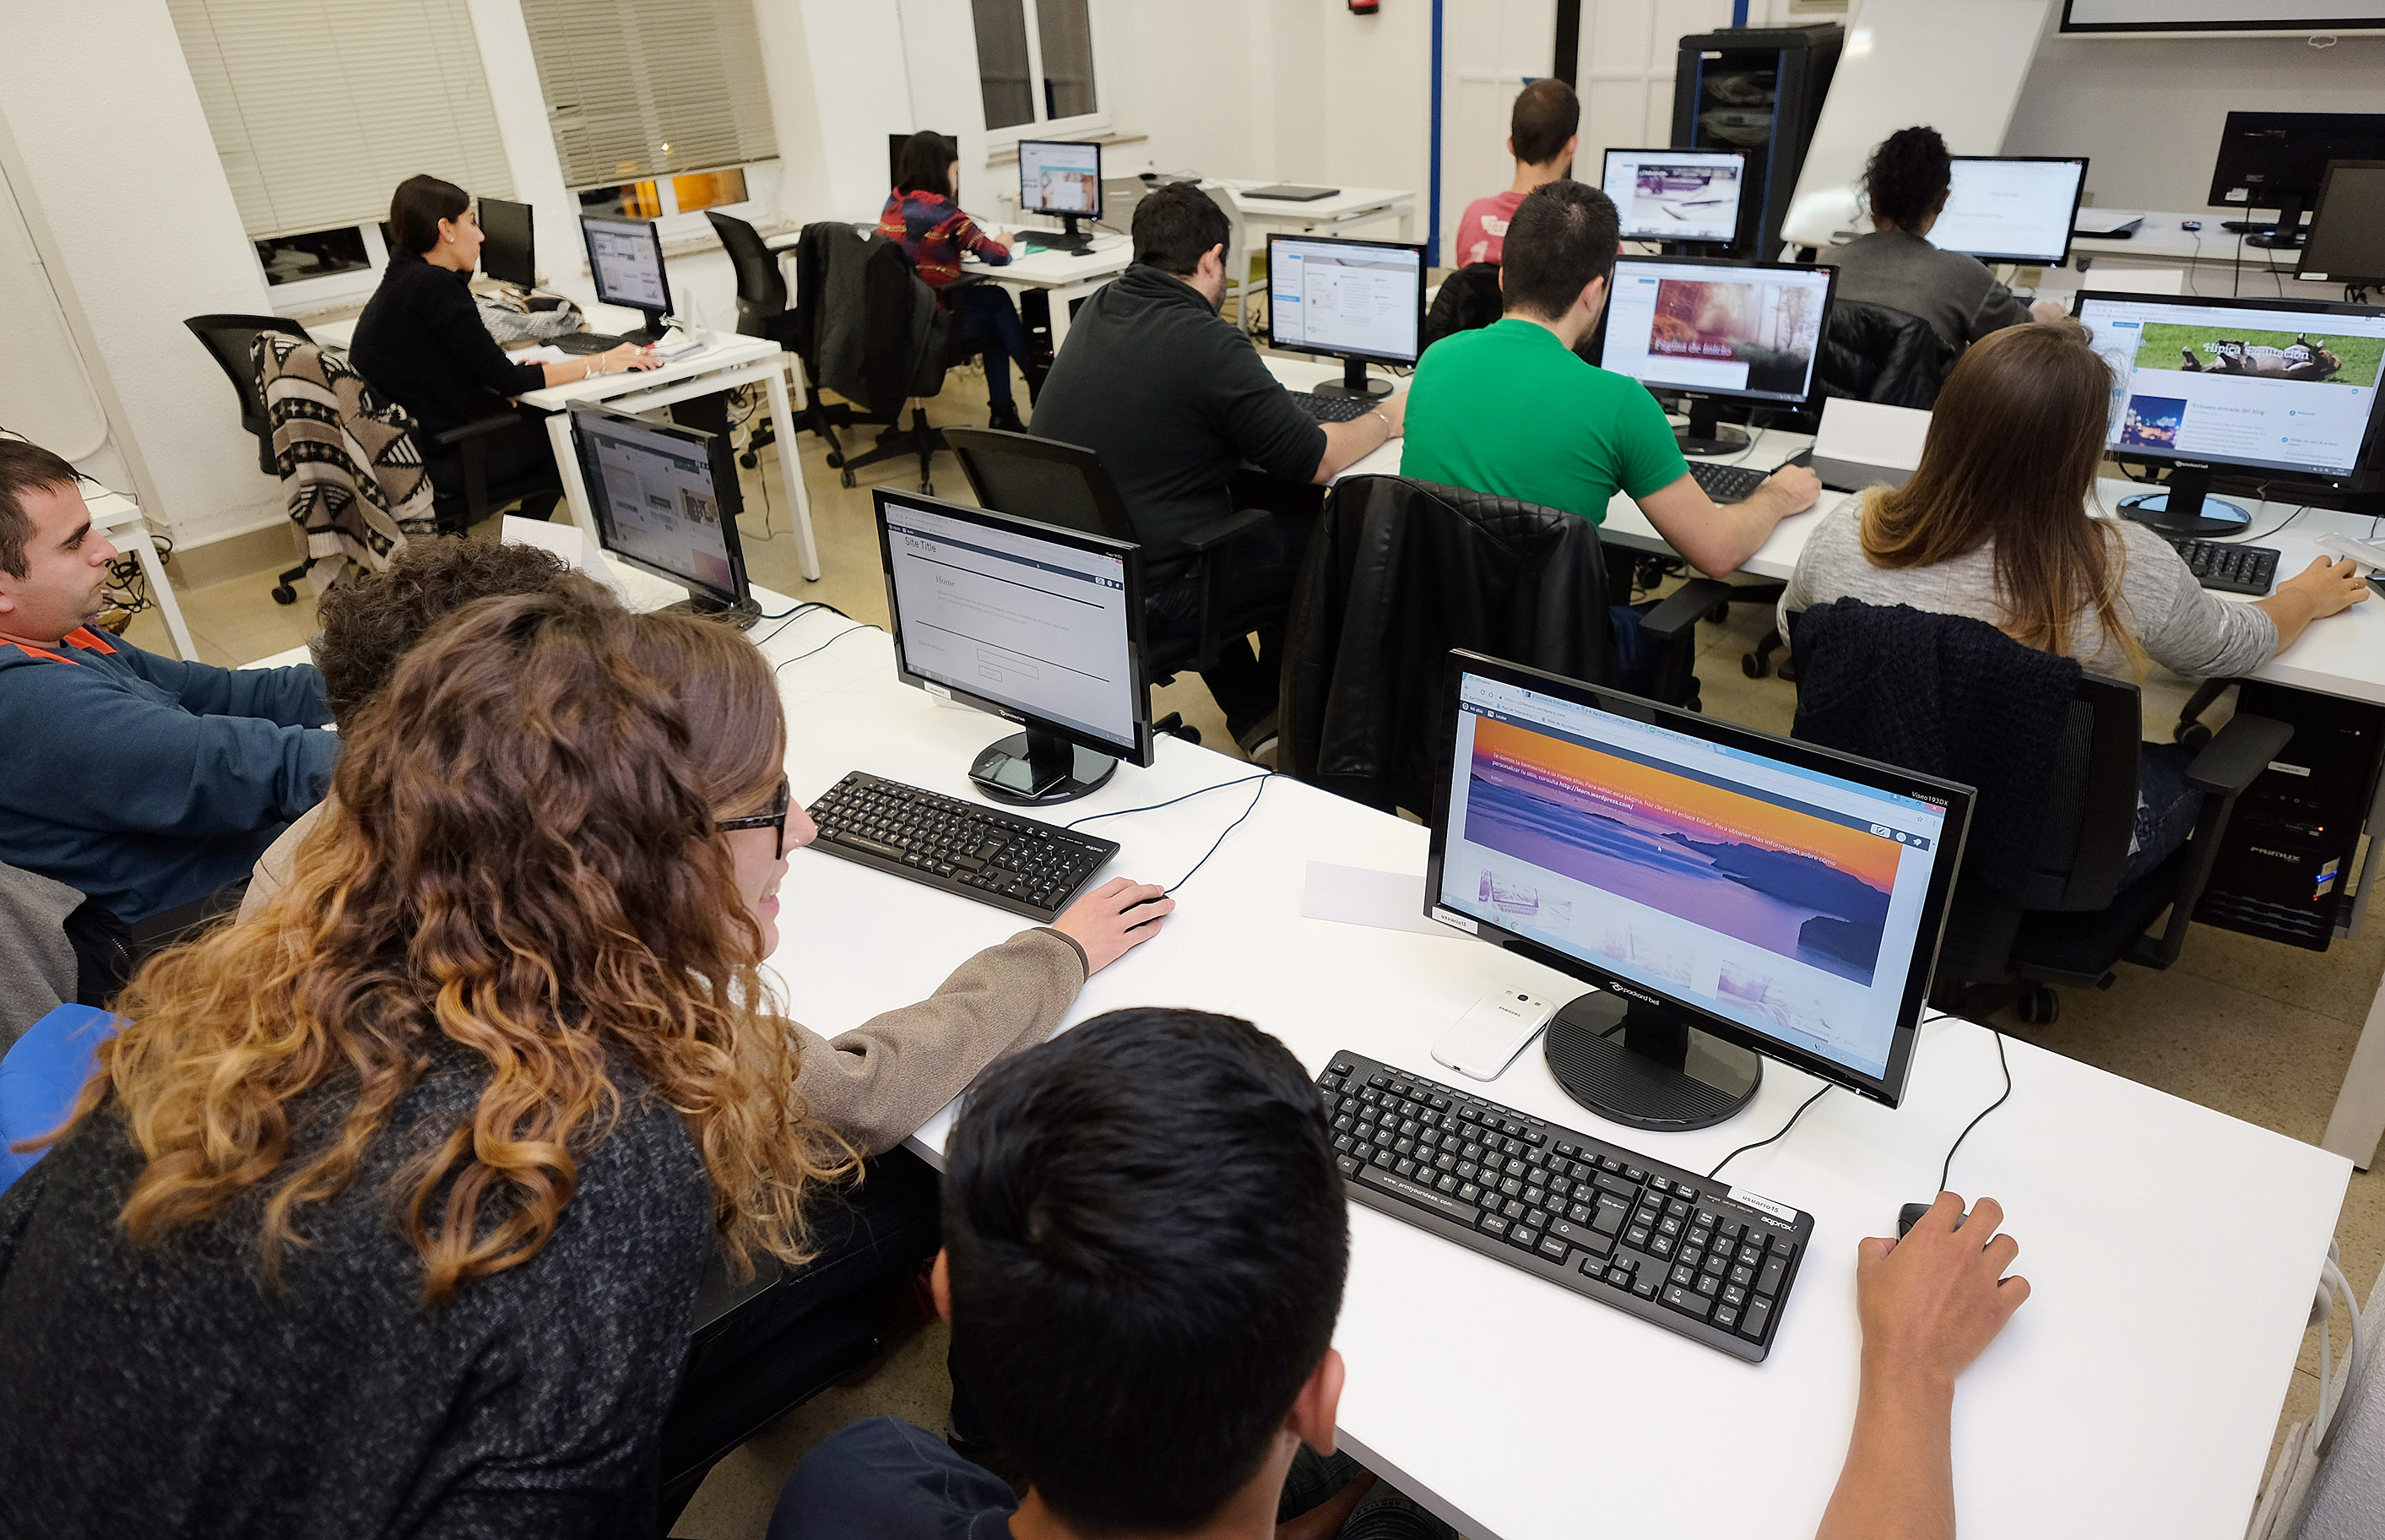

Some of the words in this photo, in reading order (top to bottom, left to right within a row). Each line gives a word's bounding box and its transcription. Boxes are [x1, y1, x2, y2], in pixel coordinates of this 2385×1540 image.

[904, 536, 919, 549] Site
[921, 540, 937, 553] Title
[935, 575, 956, 588] Home
[1492, 760, 1520, 774] personalizar
[1538, 774, 1559, 787] consulta
[1911, 791, 1949, 806] Viseo193DX
[1499, 754, 1515, 765] damos
[1520, 759, 1547, 775] bienvenida
[1558, 773, 1573, 783] nuevo
[1585, 781, 1597, 790] Para
[1597, 784, 1613, 795] editar
[1613, 789, 1624, 800] esta
[1654, 802, 1663, 811] clic
[1678, 810, 1696, 822] enlace
[1715, 822, 1728, 832] Para
[1728, 827, 1751, 839] obtener
[1751, 833, 1764, 843] más
[1764, 837, 1800, 855] información
[1801, 850, 1818, 861] sobre
[1819, 854, 1837, 867] cómo
[1440, 914, 1467, 927] usuario15
[1623, 987, 1648, 1002] packard
[1648, 993, 1660, 1006] bell
[1383, 1176, 1397, 1185] www.
[1398, 1183, 1439, 1202] printyourideas.
[1439, 1198, 1453, 1207] com
[1742, 1196, 1780, 1213] usuario15
